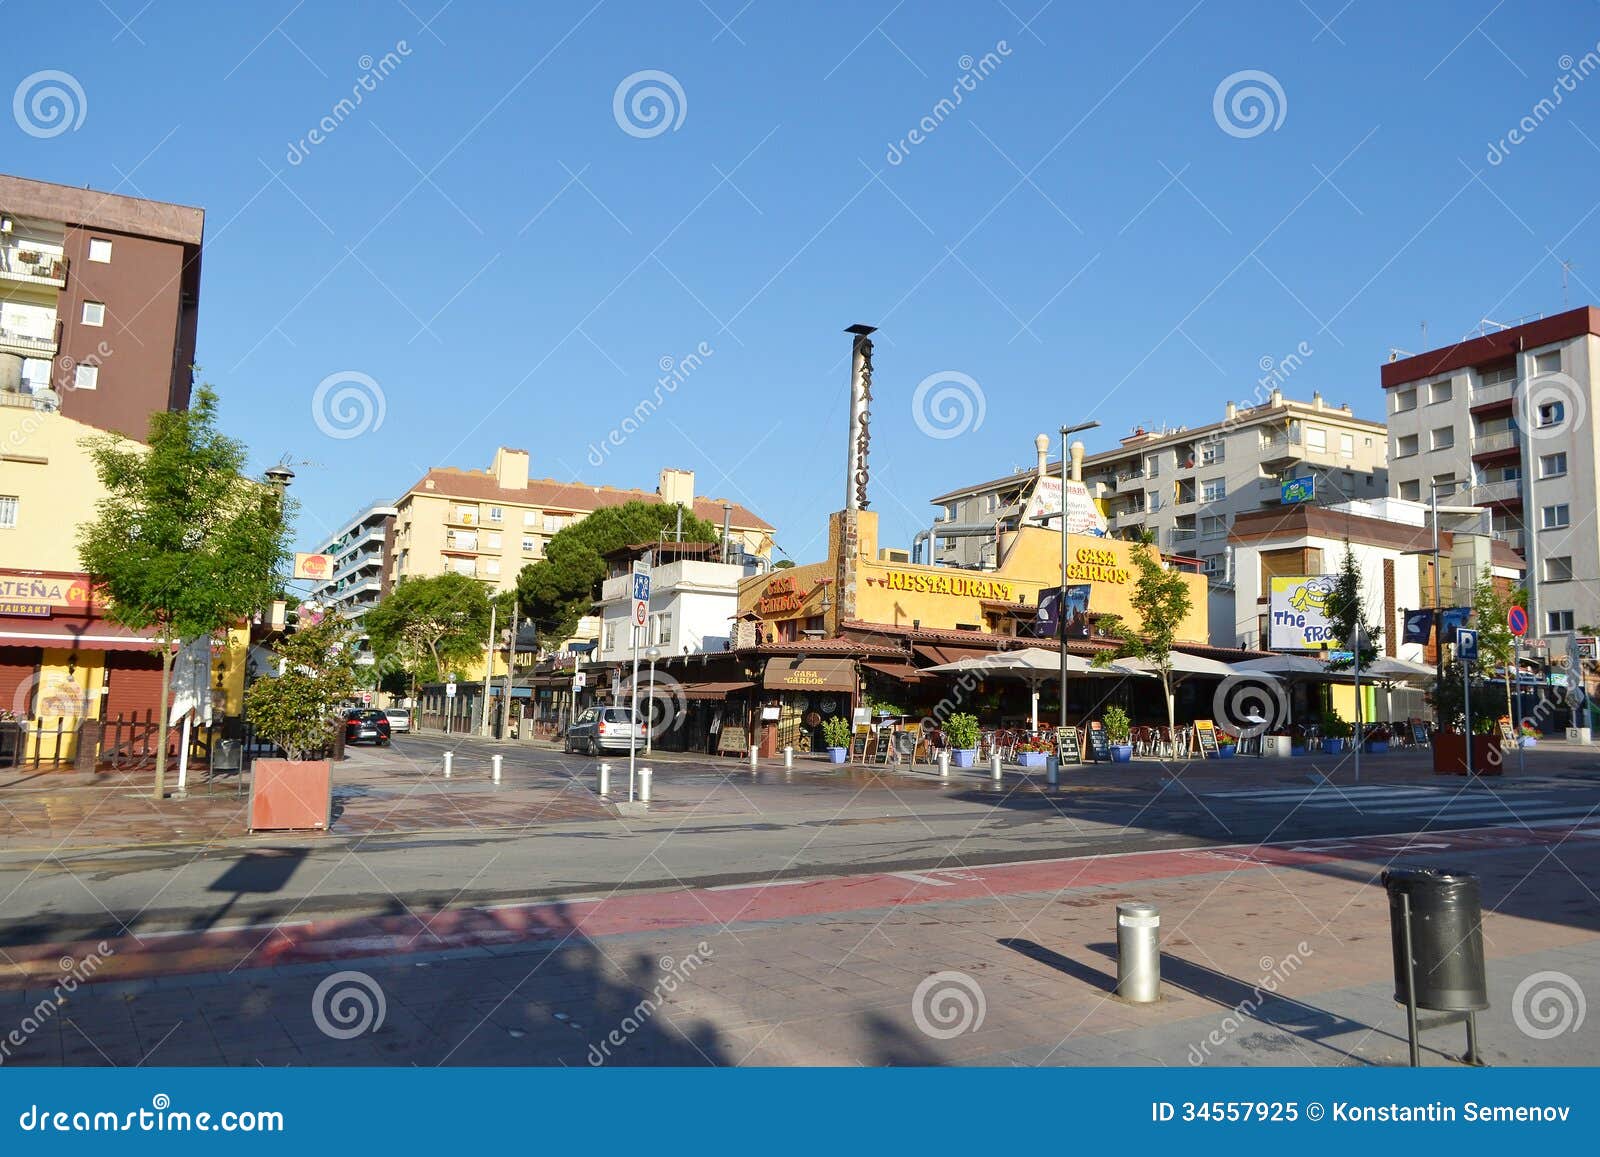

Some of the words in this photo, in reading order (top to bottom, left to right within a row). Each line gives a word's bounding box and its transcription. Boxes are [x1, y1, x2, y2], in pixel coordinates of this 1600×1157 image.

[1076, 547, 1118, 567] CASA
[887, 569, 1016, 601] RESTAURANT
[1274, 611, 1305, 628] The
[1460, 632, 1474, 656] P
